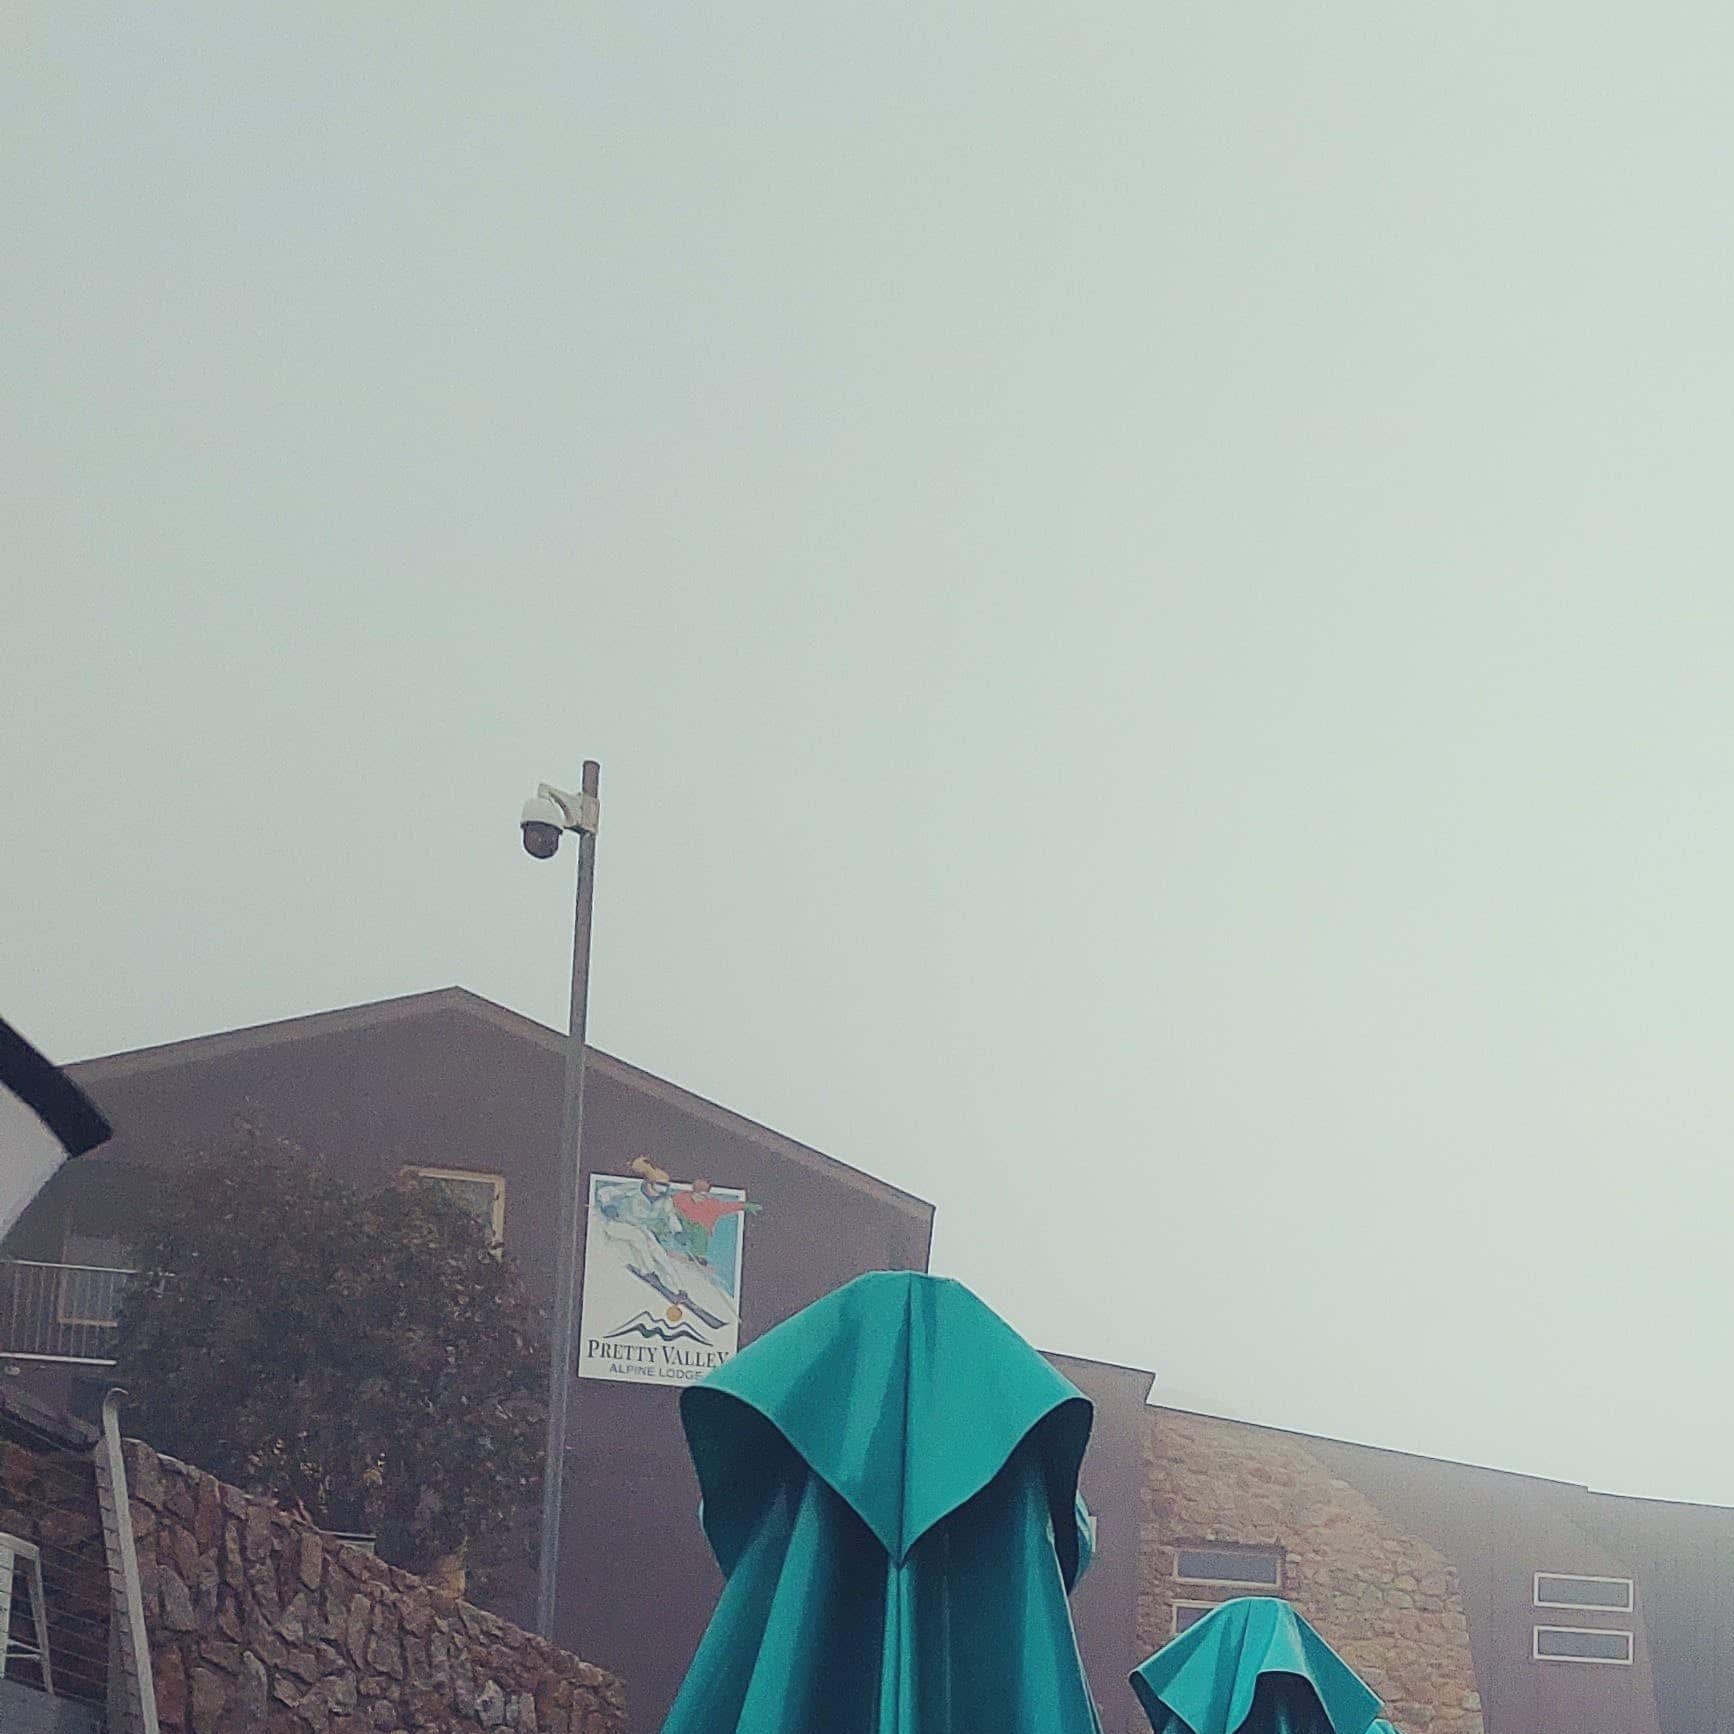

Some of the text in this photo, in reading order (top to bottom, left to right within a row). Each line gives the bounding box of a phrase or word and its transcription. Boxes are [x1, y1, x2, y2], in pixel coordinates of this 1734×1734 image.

[587, 1339, 729, 1368] PRETTY VALLEY
[609, 1363, 702, 1379] ALPINE LODGE
